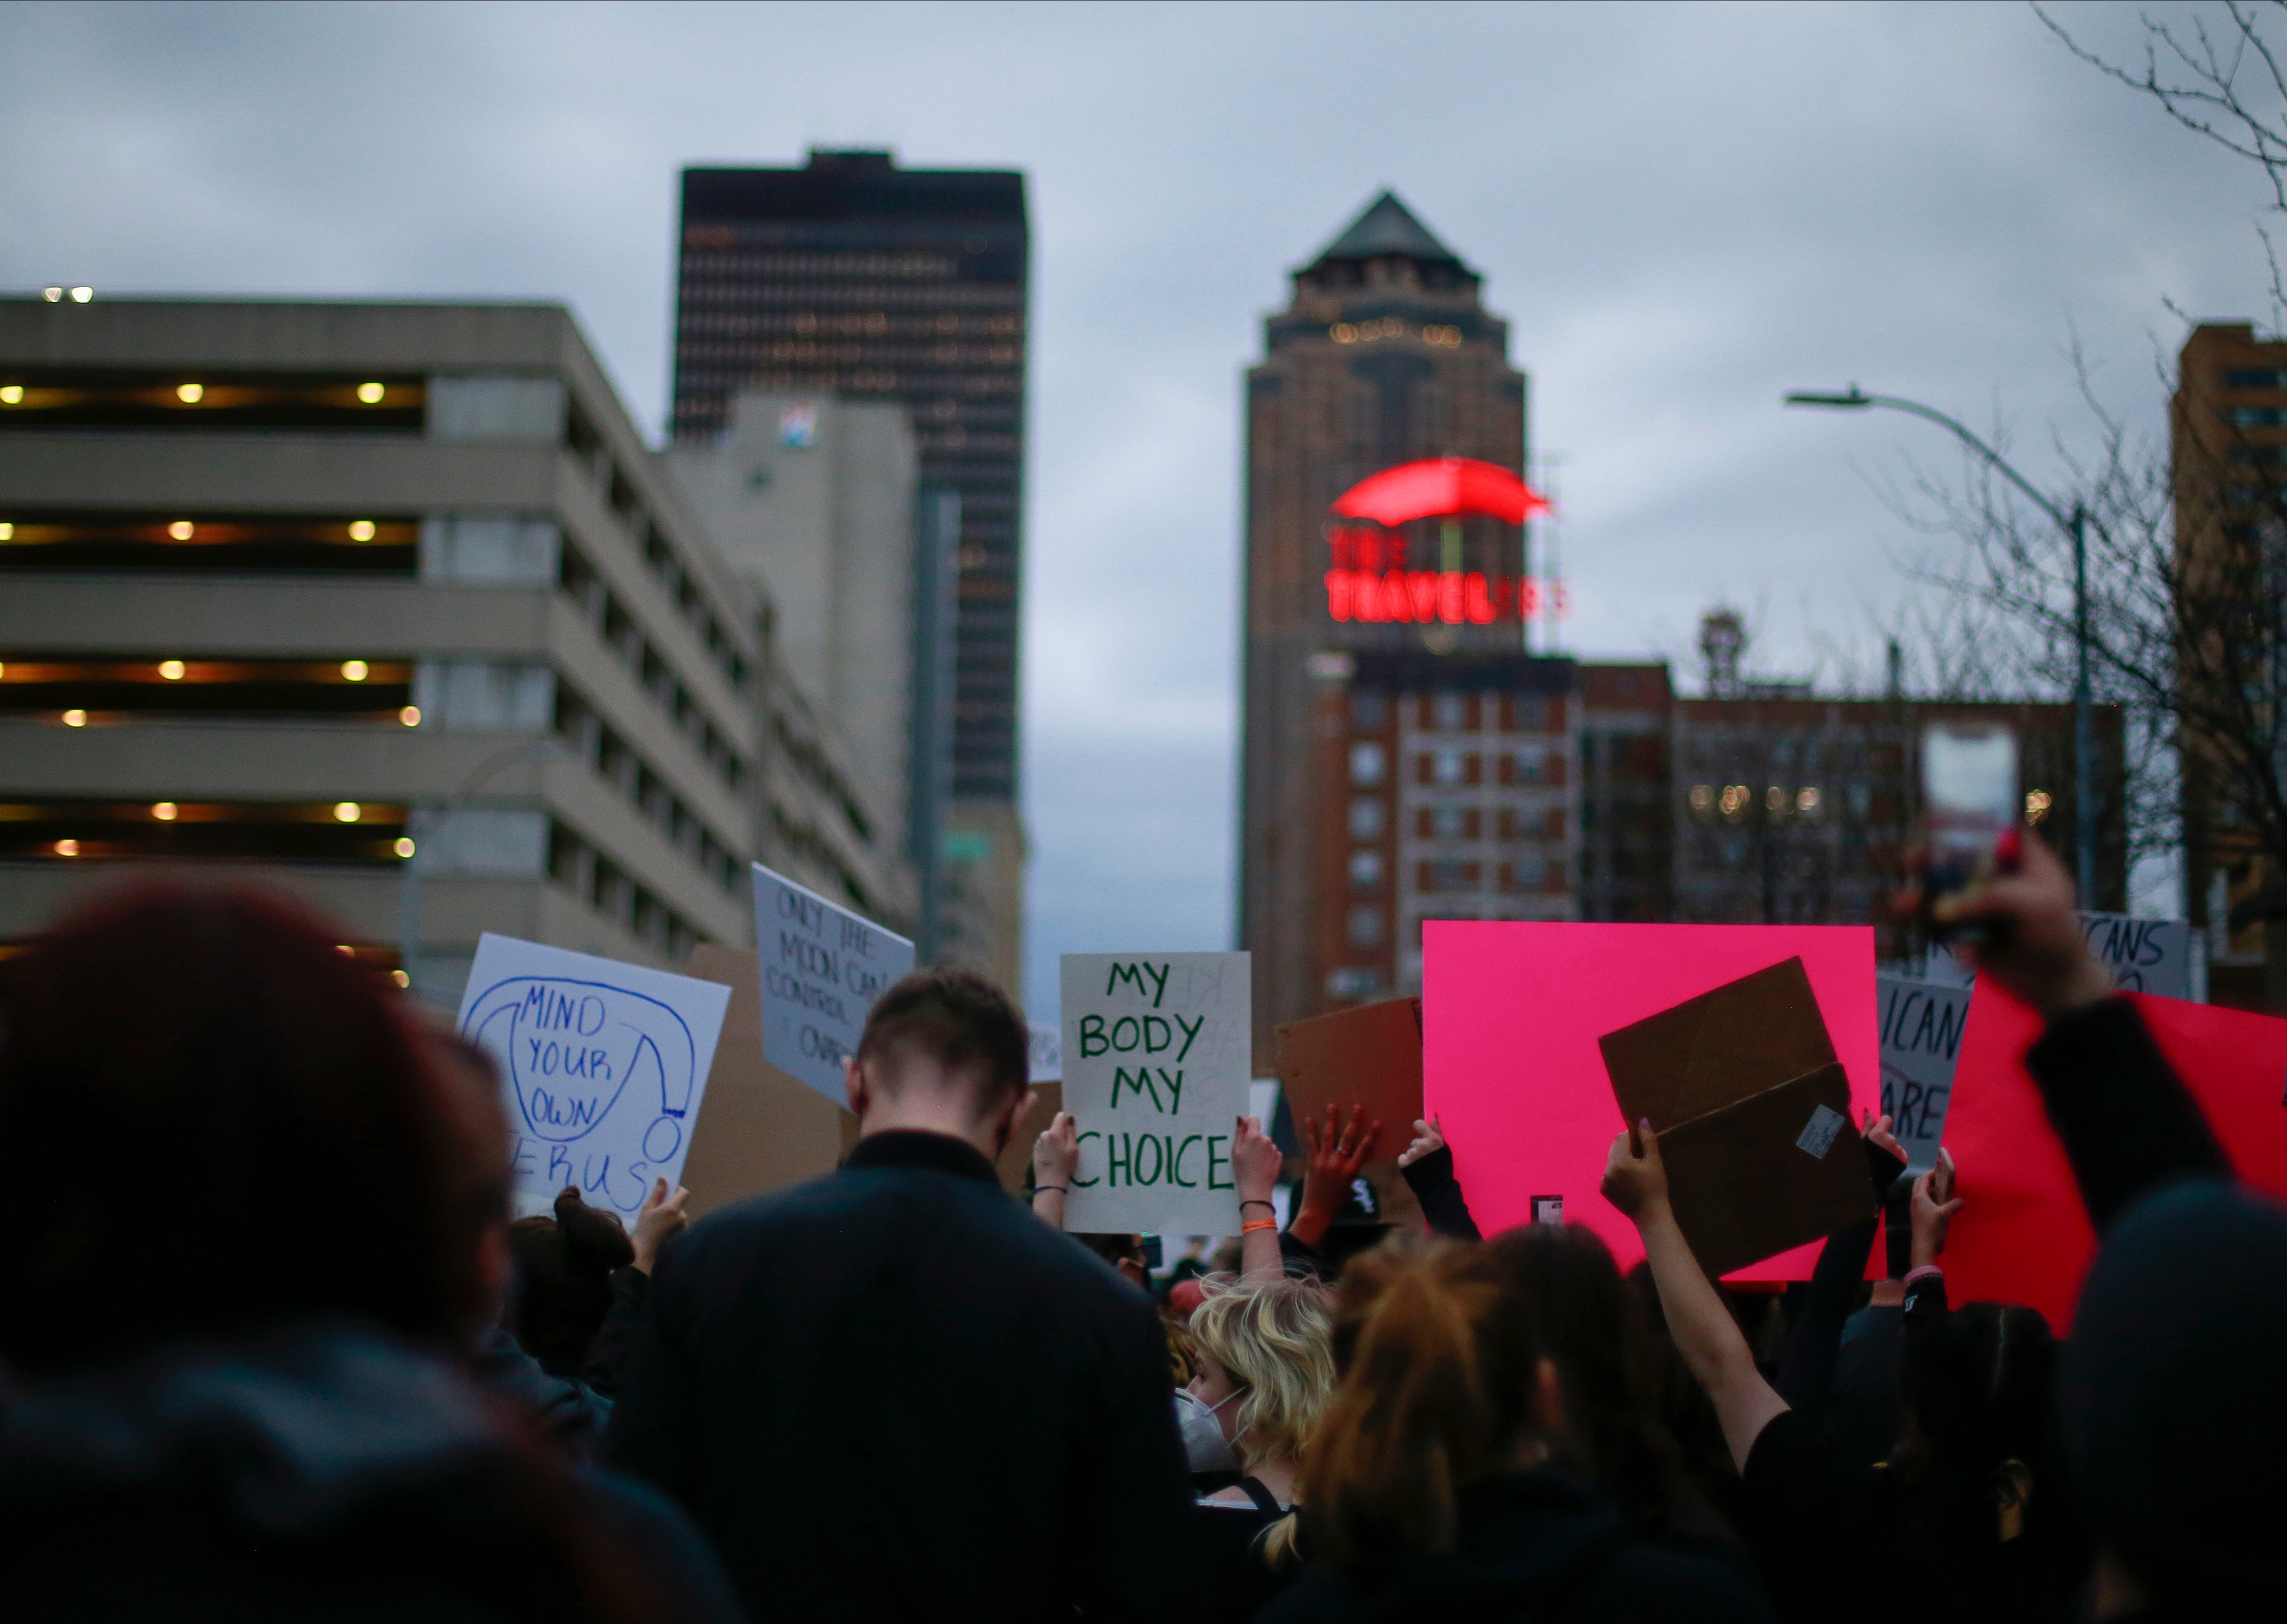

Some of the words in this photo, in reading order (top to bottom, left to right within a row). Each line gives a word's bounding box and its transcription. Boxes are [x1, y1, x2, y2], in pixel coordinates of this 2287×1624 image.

[1107, 960, 1169, 1008] MY
[520, 985, 605, 1036] MIND
[529, 1038, 611, 1080] YOUR
[1080, 1013, 1204, 1063] BODY
[530, 1087, 597, 1127] OWN
[1111, 1066, 1183, 1115] MY
[1070, 1132, 1234, 1189] CHOICE
